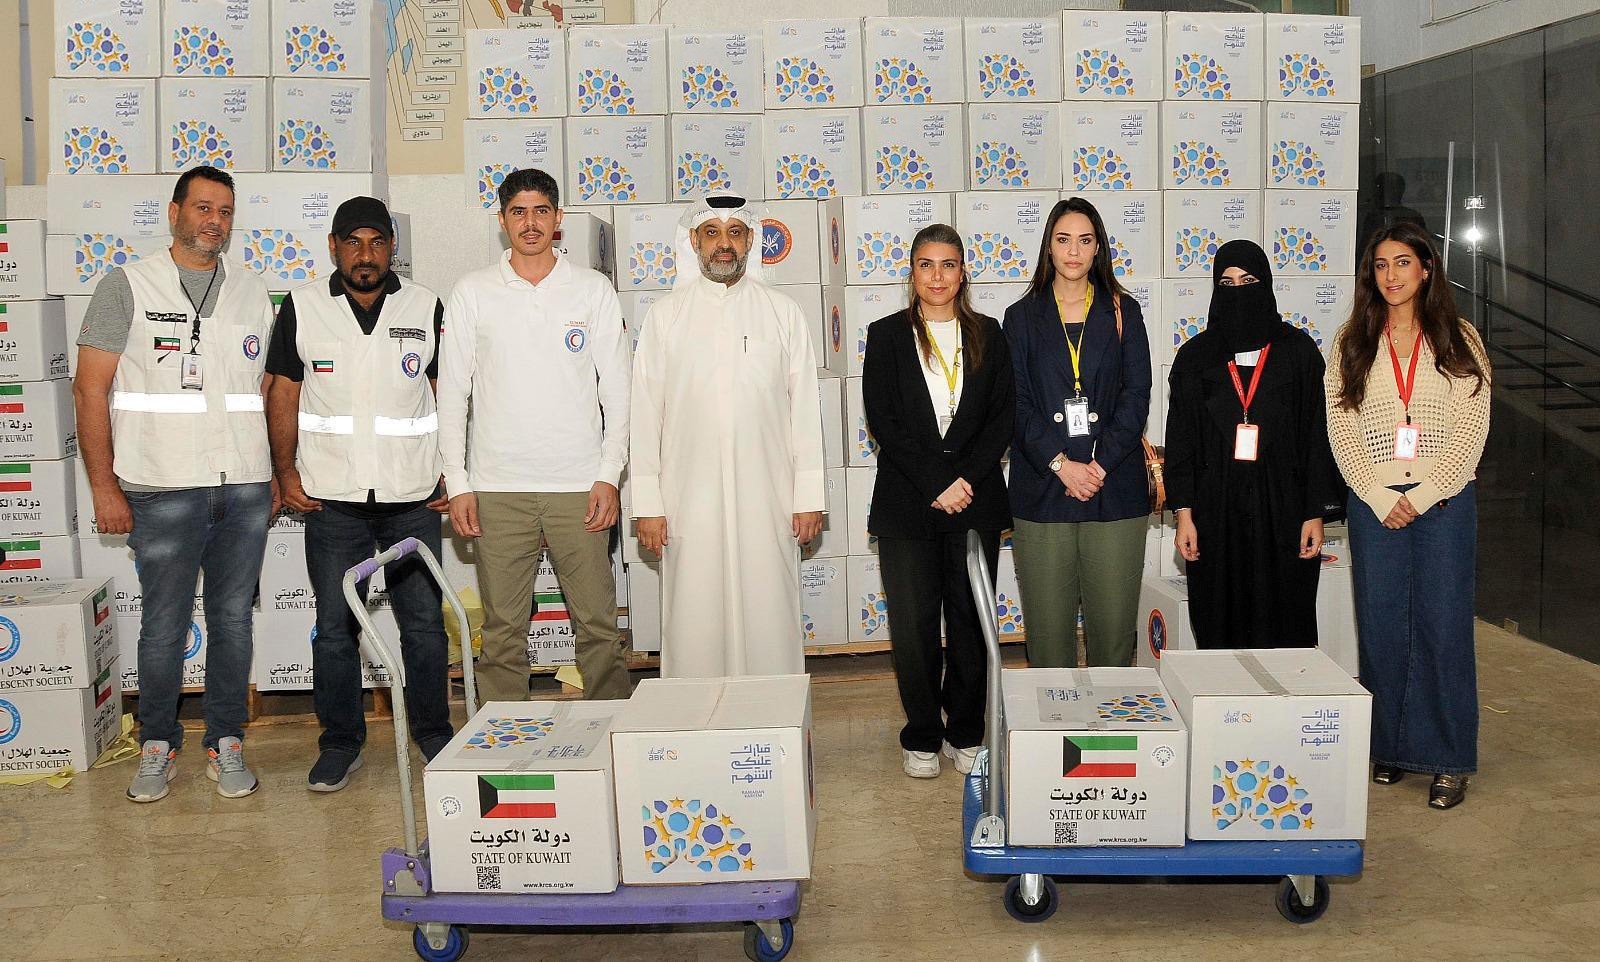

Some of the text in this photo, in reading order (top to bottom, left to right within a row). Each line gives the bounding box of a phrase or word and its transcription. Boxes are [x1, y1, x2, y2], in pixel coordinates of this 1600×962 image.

[0, 354, 17, 362] WAIT
[10, 419, 32, 431] دولة
[6, 434, 34, 442] KUWAIT
[17, 498, 40, 510] دولة
[12, 512, 42, 520] KUWAIT
[275, 588, 308, 600] الكويتي
[275, 601, 306, 610] KUWAIT
[528, 626, 576, 639] ولة الكوي
[554, 640, 575, 648] KUWA
[8, 664, 72, 677] جمية الهلال
[270, 663, 302, 675] الكويتي
[0, 676, 74, 689] ESCENT SOCIETY
[270, 676, 313, 684] KUWAIT RE
[364, 674, 388, 682] SOCIE
[1302, 709, 1340, 722] مبارك
[1301, 721, 1339, 734] عليكم
[1301, 734, 1340, 746] الشهر
[8, 748, 72, 760] جمعية الهلال
[730, 744, 770, 756] مبارك
[0, 759, 72, 771] ESCENT SOCIETY
[731, 756, 772, 770] عليكم
[731, 770, 772, 784] الشهر
[1111, 786, 1147, 805] دولة
[1050, 809, 1147, 820] STATE OF KUWAIT
[470, 829, 570, 848] دولة الكويت
[472, 852, 572, 864] STATE OF KUWAIT
